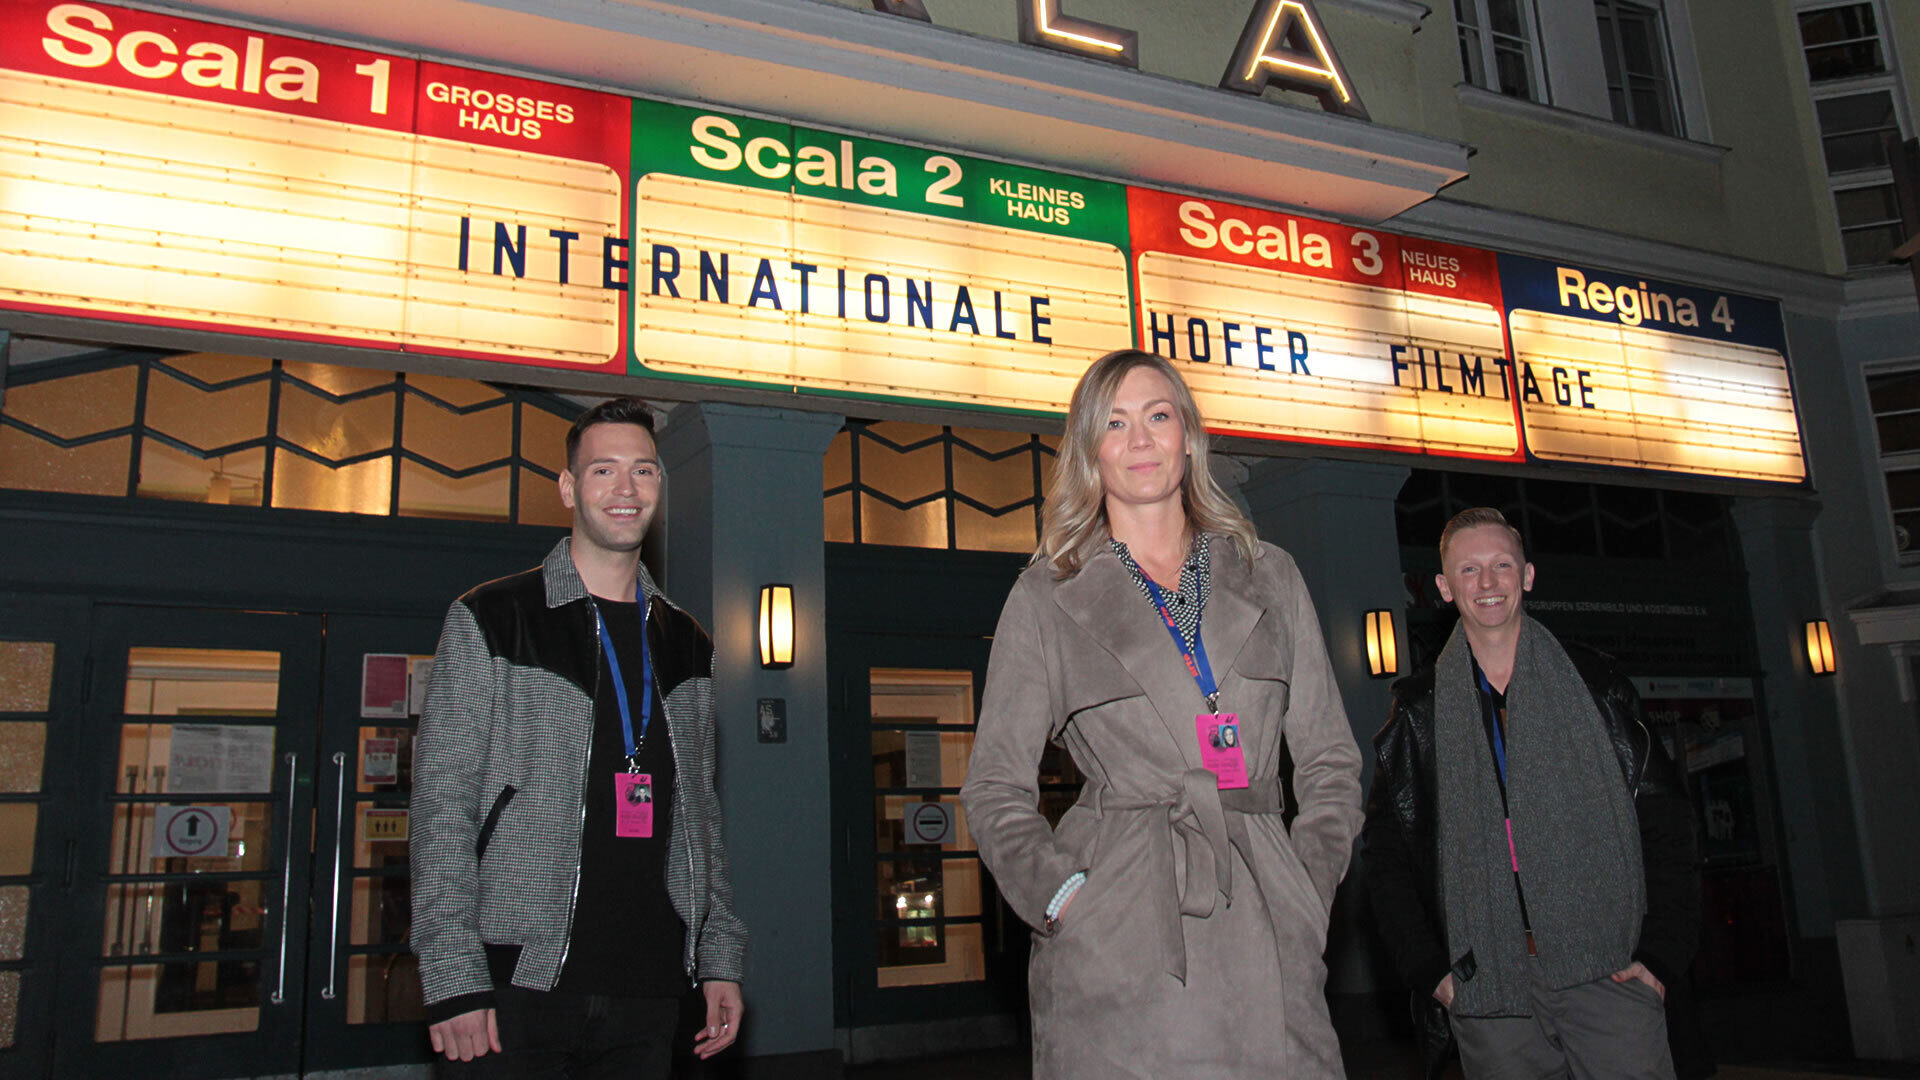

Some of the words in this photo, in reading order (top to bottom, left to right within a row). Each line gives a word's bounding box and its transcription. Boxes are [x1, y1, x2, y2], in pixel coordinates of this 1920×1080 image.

[42, 3, 319, 104] Scala
[355, 58, 391, 115] 1
[872, 0, 1373, 121] LA
[426, 82, 575, 125] GROSSES
[458, 109, 542, 140] HAUS
[690, 115, 898, 197] Scala
[924, 156, 964, 207] 2
[989, 178, 1086, 210] KLEINES
[1007, 200, 1070, 226] HAUS
[1178, 200, 1333, 270] Scala
[1351, 230, 1384, 276] 3
[1402, 249, 1460, 273] NEUES
[1409, 266, 1456, 289] HAUS
[458, 216, 1053, 345] INTERNATIONALE
[1150, 311, 1312, 376] HOFER
[1390, 344, 1597, 410] FILMTAGE
[1556, 266, 1699, 328] Regina
[1711, 295, 1735, 333] 4
[1523, 600, 1575, 611] FSGRUPPEN
